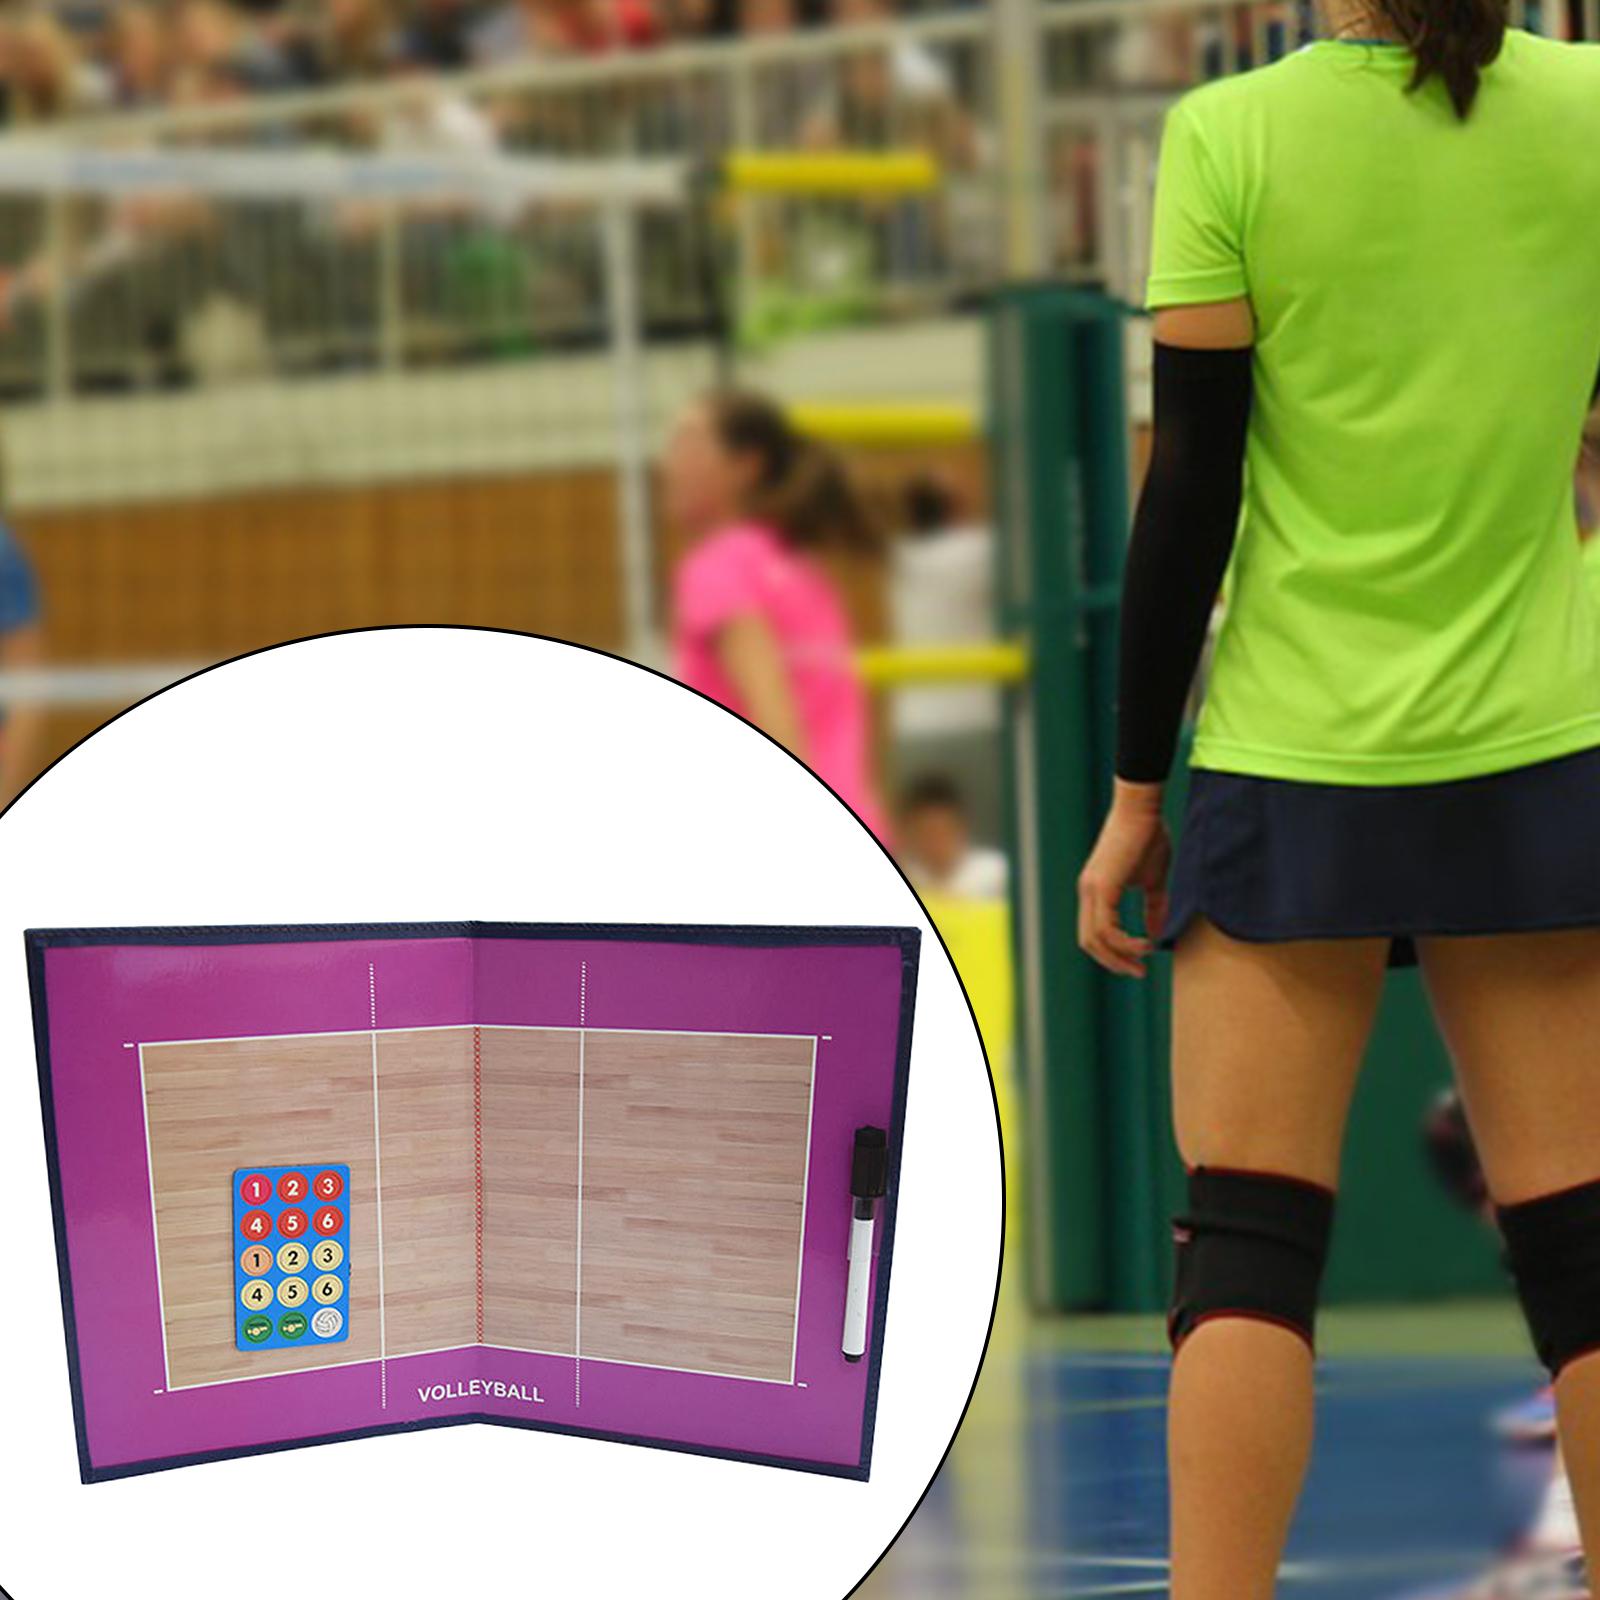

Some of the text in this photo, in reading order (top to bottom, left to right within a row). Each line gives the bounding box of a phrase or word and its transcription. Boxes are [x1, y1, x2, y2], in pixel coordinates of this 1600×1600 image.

[252, 1178, 334, 1198] 1 2 3
[250, 1213, 334, 1233] 4 5 6
[252, 1248, 333, 1267] 1 2 3
[251, 1282, 333, 1302] 4 5 6
[418, 1379, 545, 1403] VOLLEYBALL
